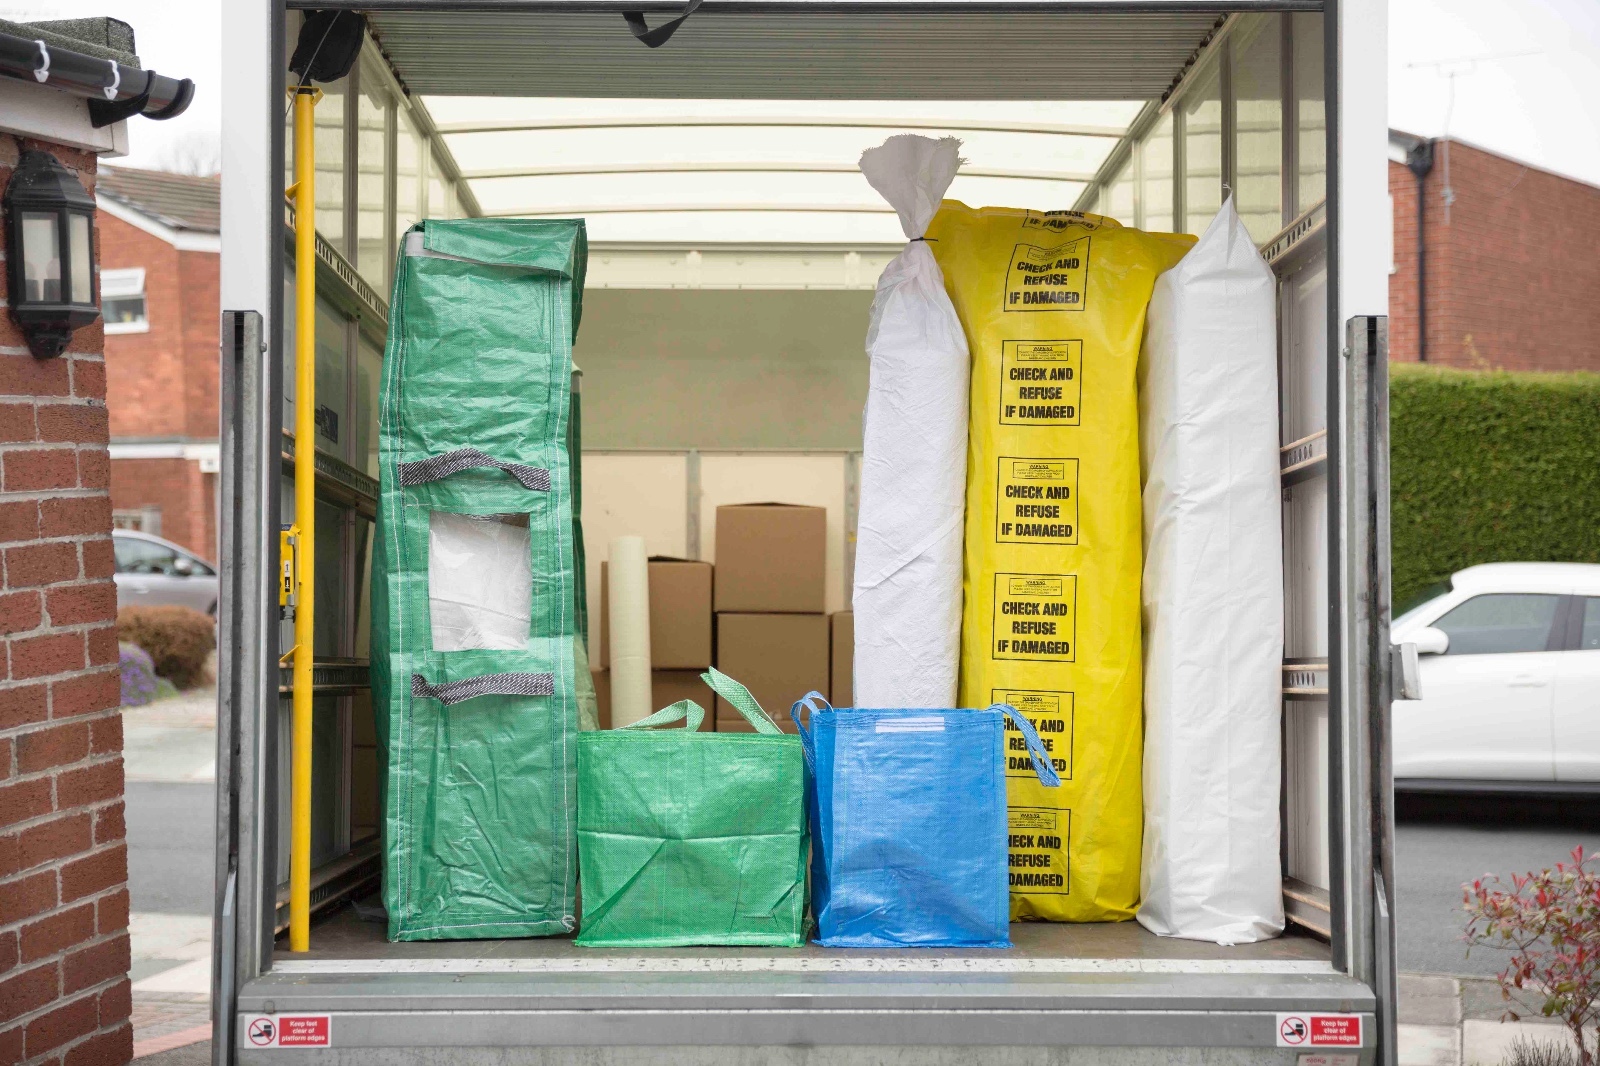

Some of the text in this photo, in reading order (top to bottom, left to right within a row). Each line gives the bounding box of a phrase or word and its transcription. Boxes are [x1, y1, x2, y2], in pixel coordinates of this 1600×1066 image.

[1016, 258, 1080, 273] CHECK AND
[1024, 274, 1068, 286] REFUSE
[1009, 291, 1080, 304] IF DAMAGED
[1009, 367, 1073, 381] CHECK AND
[1019, 387, 1062, 399] REFUSE
[1005, 405, 1074, 419] IF DAMAGED
[1005, 485, 1070, 499] CHECK AND
[1015, 505, 1059, 518] REFUSE
[1001, 523, 1072, 537] IF DAMAGED
[1002, 601, 1067, 616] CHECK AND
[1012, 621, 1056, 635] REFUSE
[998, 640, 1069, 655] IF DAMAGED
[1040, 719, 1064, 732] AND
[1009, 738, 1053, 751] RESE
[1009, 757, 1067, 771] DAMAED
[1008, 835, 1061, 849] HECK AND
[1008, 854, 1050, 867] REFUSE
[1009, 873, 1063, 887] DAMAGED
